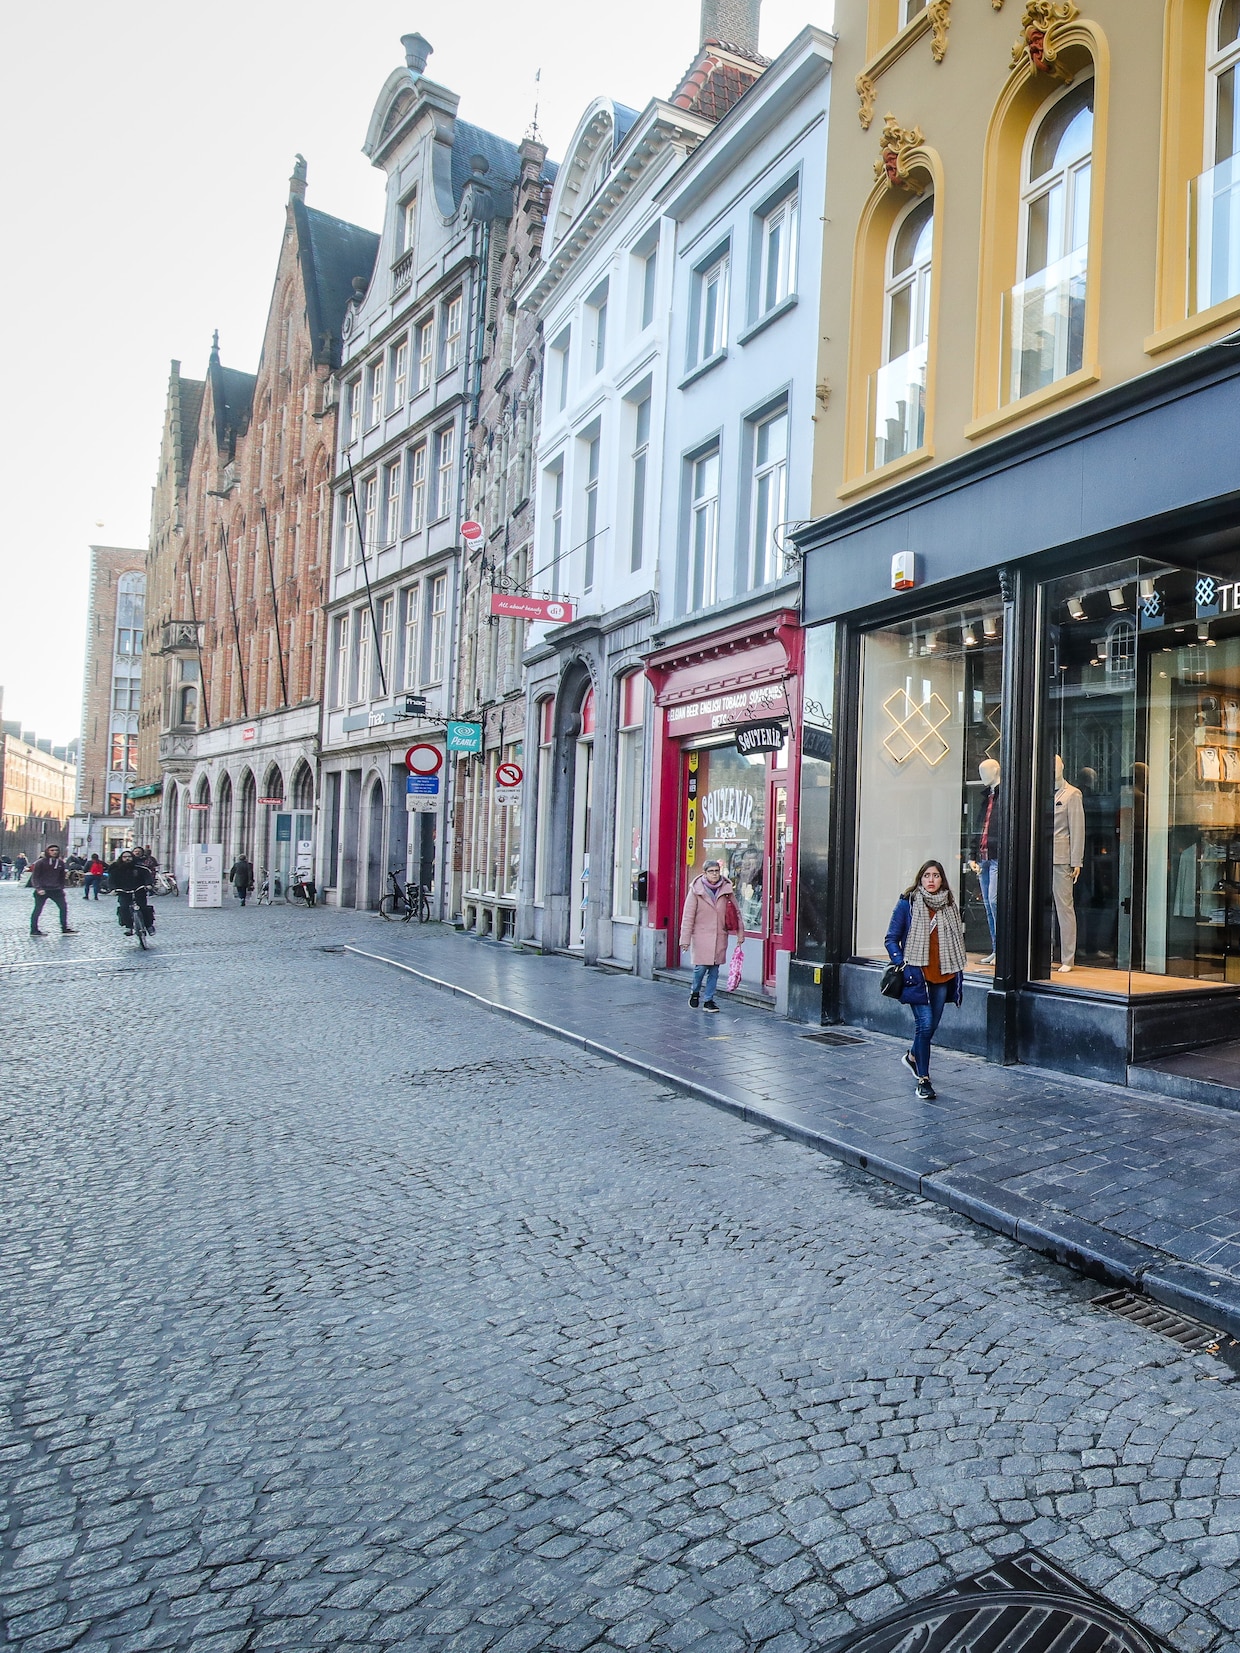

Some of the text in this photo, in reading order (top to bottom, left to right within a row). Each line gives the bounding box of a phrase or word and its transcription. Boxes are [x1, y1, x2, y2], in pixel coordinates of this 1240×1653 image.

[525, 605, 542, 615] beauty
[550, 607, 562, 615] di!
[406, 698, 427, 706] fnac
[668, 706, 686, 721] BELGIAN
[686, 704, 699, 717] BEER
[700, 698, 722, 714] ENGLISH
[722, 693, 747, 709] TOBACCO
[368, 711, 385, 727] fnac
[450, 736, 478, 747] PEARLE
[738, 728, 781, 752] SOUVENIR
[701, 787, 753, 830] SOUVENIR
[205, 857, 213, 865] P
